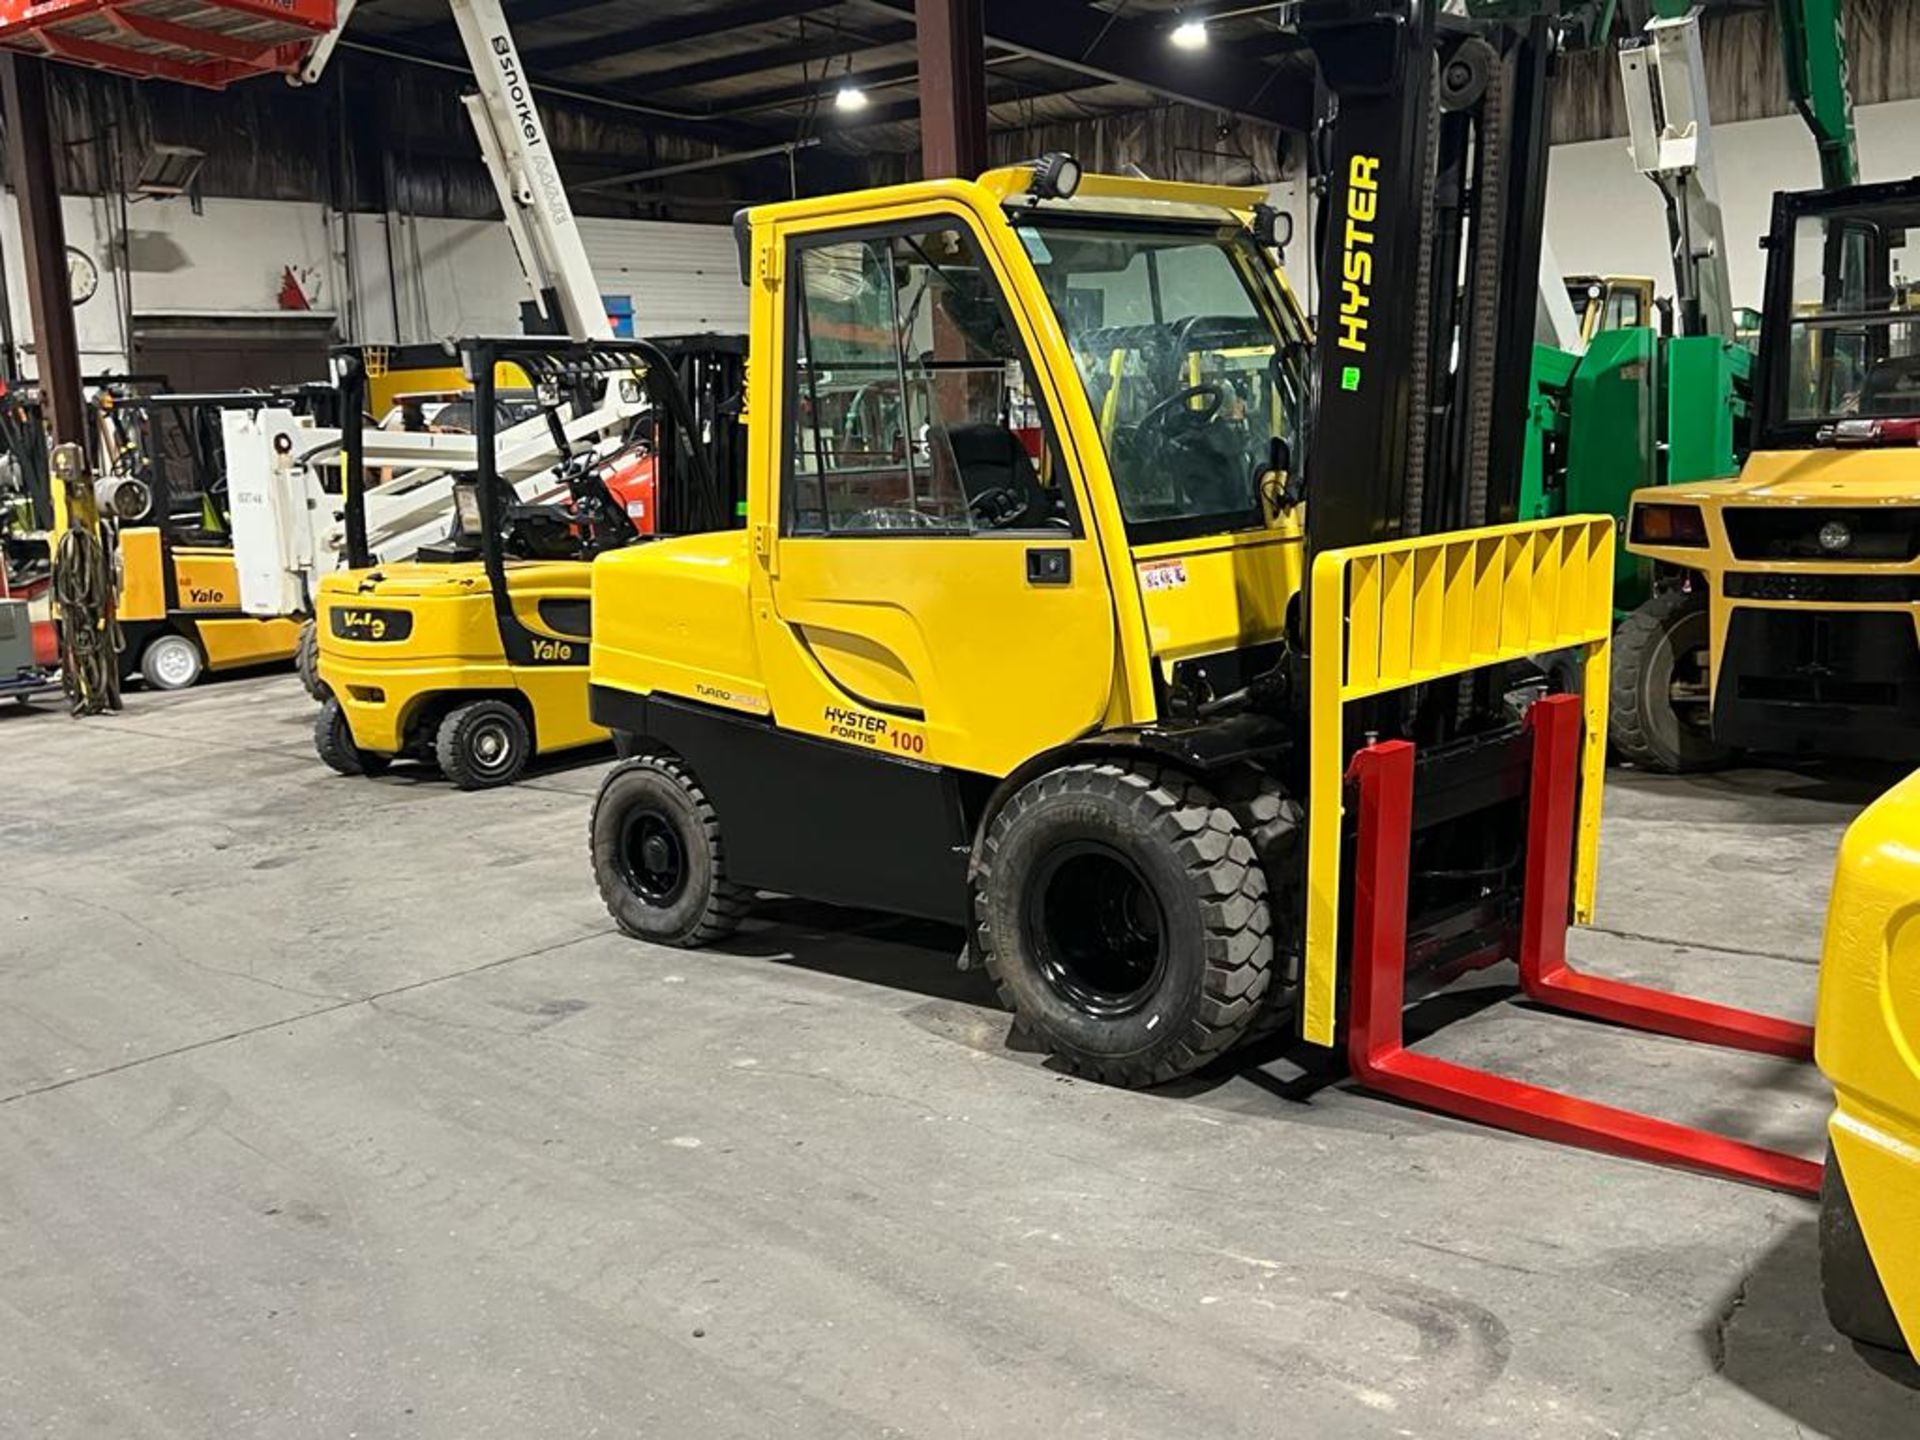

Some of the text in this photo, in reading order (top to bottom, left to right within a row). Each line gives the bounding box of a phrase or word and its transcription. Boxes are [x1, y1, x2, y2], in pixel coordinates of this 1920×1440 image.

[499, 56, 541, 147] snorkel
[1338, 154, 1379, 353] HYSTER
[190, 589, 224, 603] Yale
[531, 640, 572, 660] Yale
[824, 706, 888, 734] HYSTER
[830, 725, 924, 753] FORTIS 100
